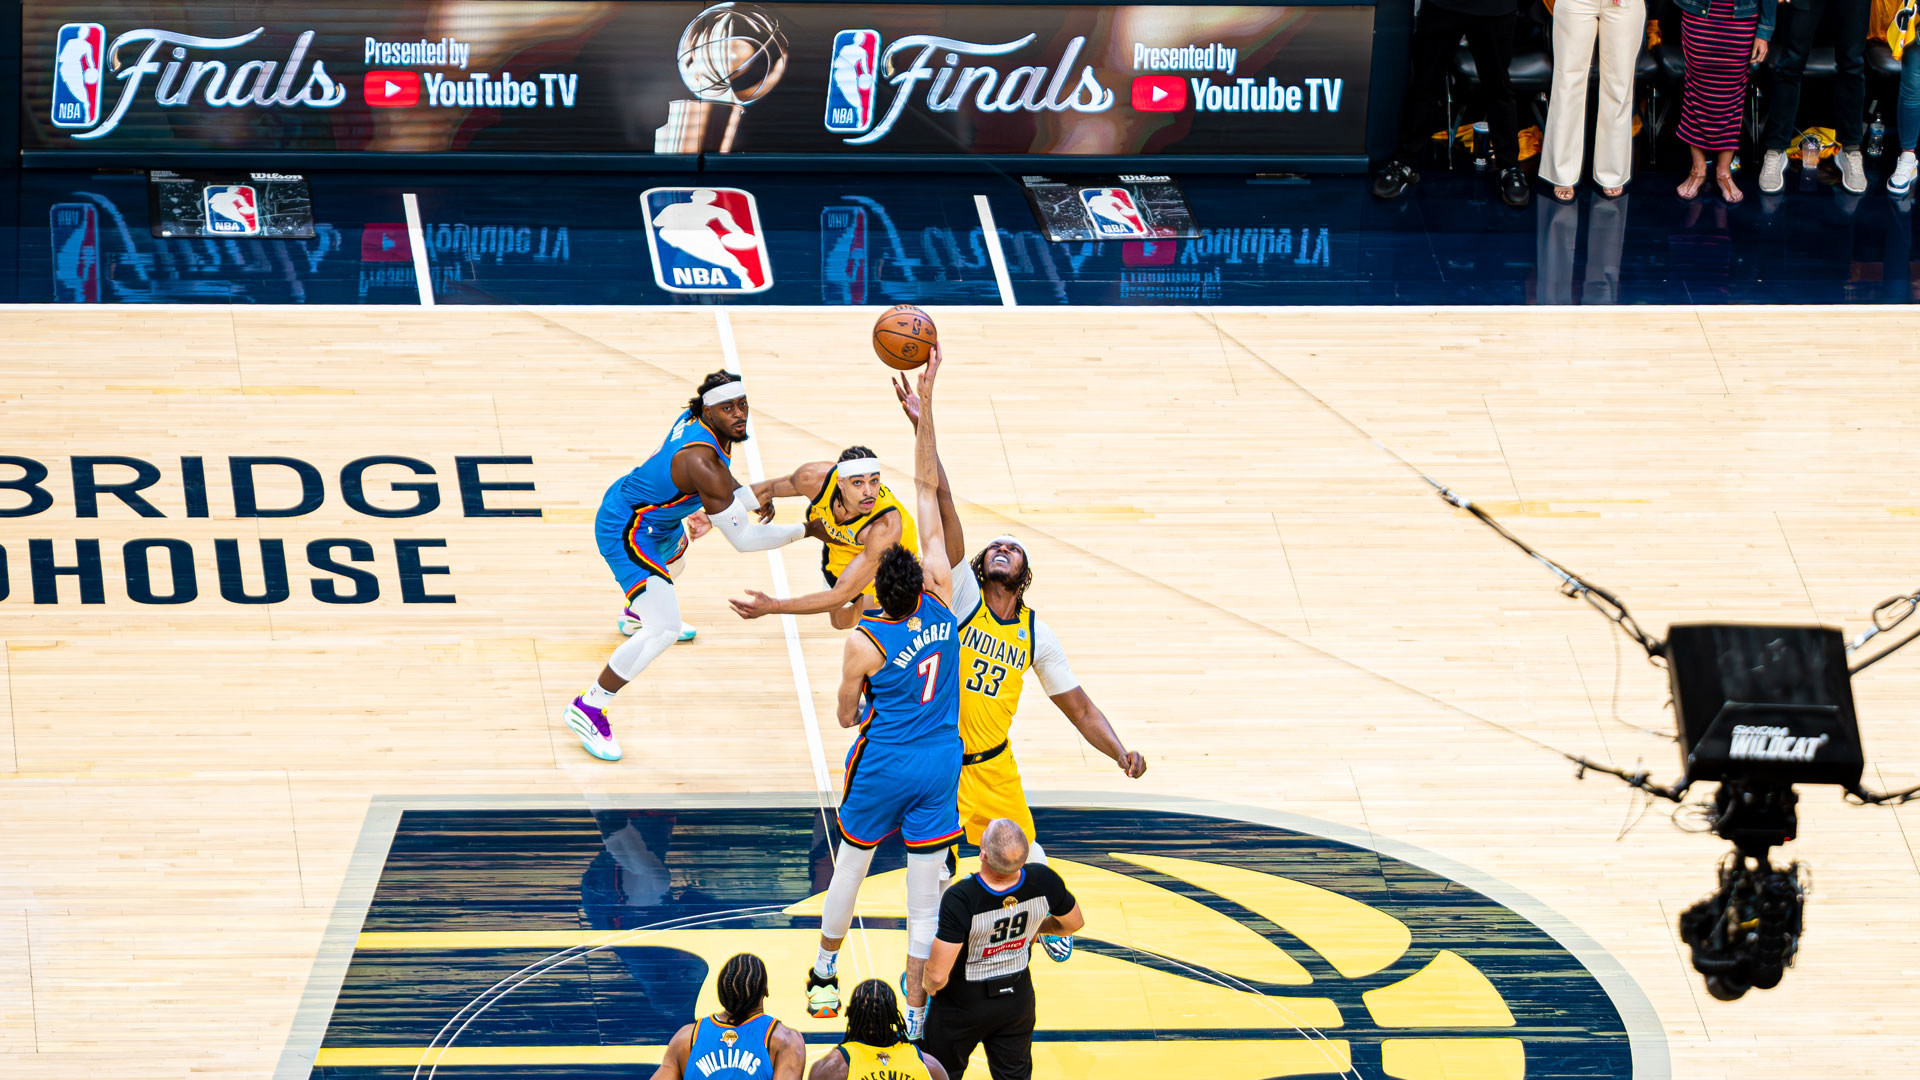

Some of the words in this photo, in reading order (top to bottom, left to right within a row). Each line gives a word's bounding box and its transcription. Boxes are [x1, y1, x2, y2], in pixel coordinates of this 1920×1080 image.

[364, 37, 448, 65] Presented
[449, 37, 470, 70] by
[1133, 42, 1216, 71] Presented
[1217, 43, 1237, 75] by
[70, 26, 346, 140] Finals
[423, 72, 538, 107] YouTube
[539, 73, 578, 107] TV
[843, 32, 1114, 144] Finals
[1190, 77, 1302, 112] YouTube
[1305, 78, 1343, 112] TV
[58, 102, 81, 119] NBA
[832, 108, 854, 124] NBA
[250, 172, 303, 180] Wilson
[215, 221, 240, 231] NBA
[1102, 224, 1130, 234] NBA
[672, 267, 729, 285] NBA
[0, 455, 543, 518] BRIDGE
[0, 537, 457, 605] HOUSE
[962, 626, 1027, 671] INDIANA
[917, 651, 941, 706] 7
[965, 657, 1007, 697] 33
[1729, 735, 1822, 762] WILDCAT
[989, 911, 1029, 944] 39
[695, 1048, 762, 1078] WILLIAMS
[861, 1070, 916, 1080] ESMIT
